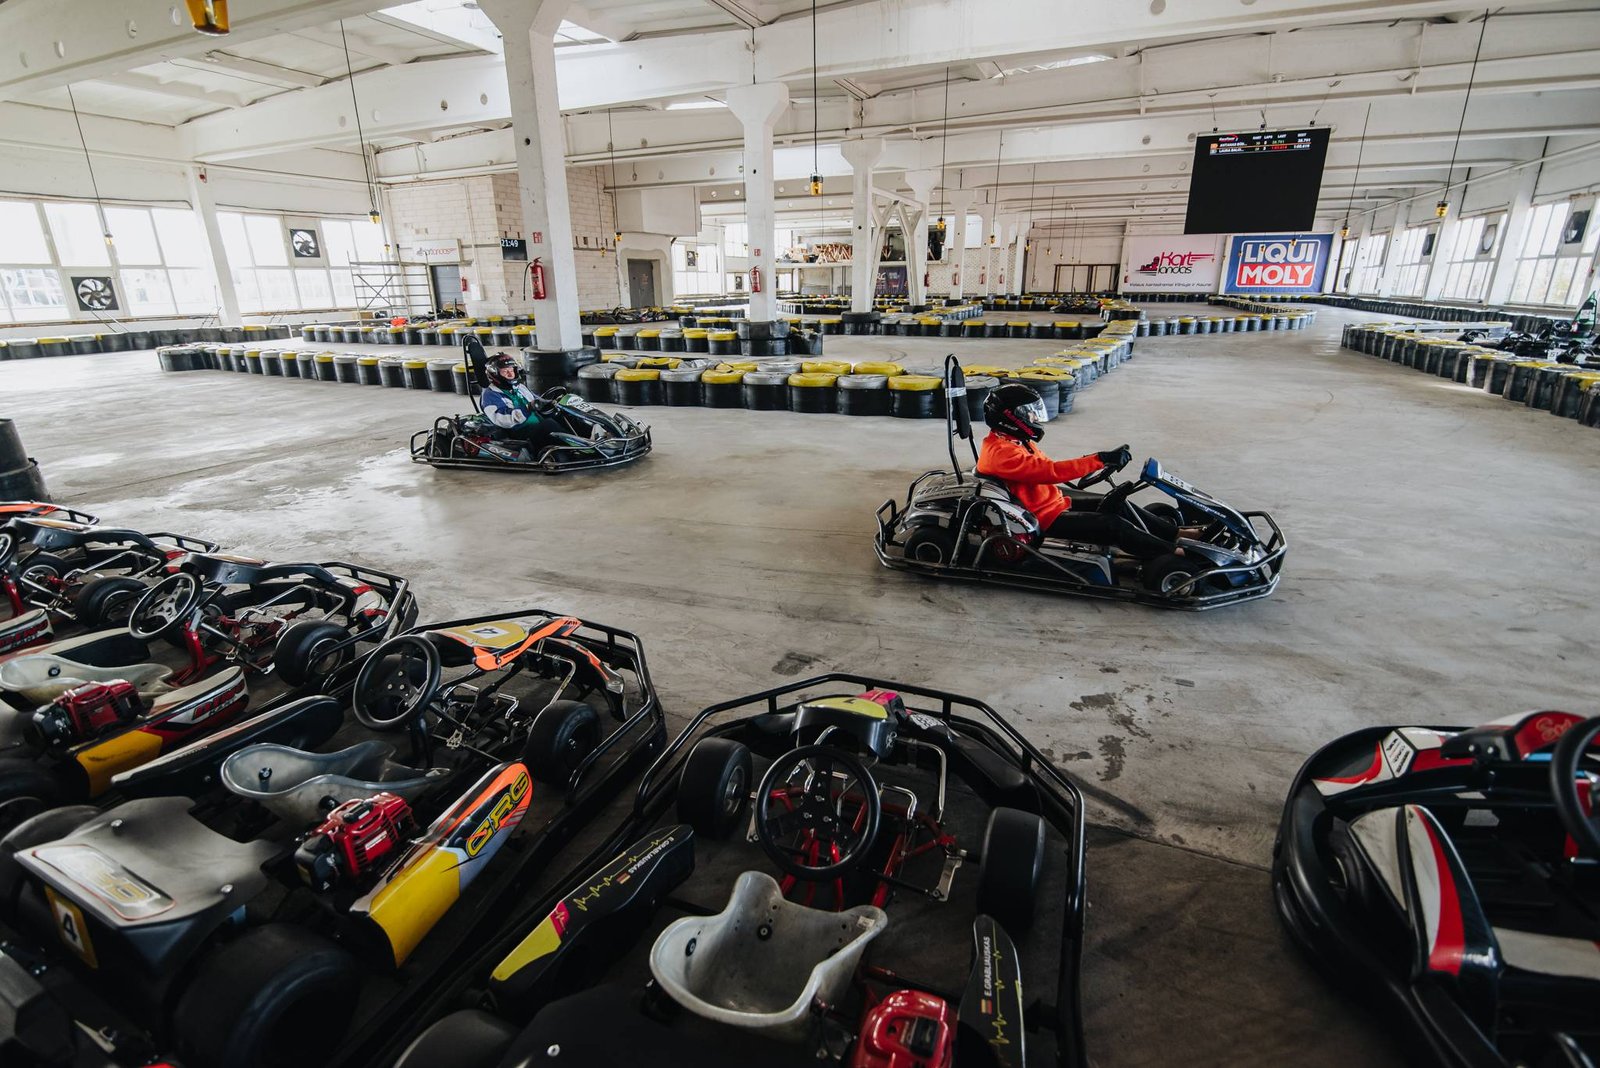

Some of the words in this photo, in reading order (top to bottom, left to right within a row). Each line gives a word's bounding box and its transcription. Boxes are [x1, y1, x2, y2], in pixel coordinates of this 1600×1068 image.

[1159, 251, 1193, 266] Kart
[1244, 243, 1316, 263] LIQUI
[1240, 265, 1313, 285] MOLY
[466, 771, 529, 858] CRG
[63, 912, 78, 942] 4
